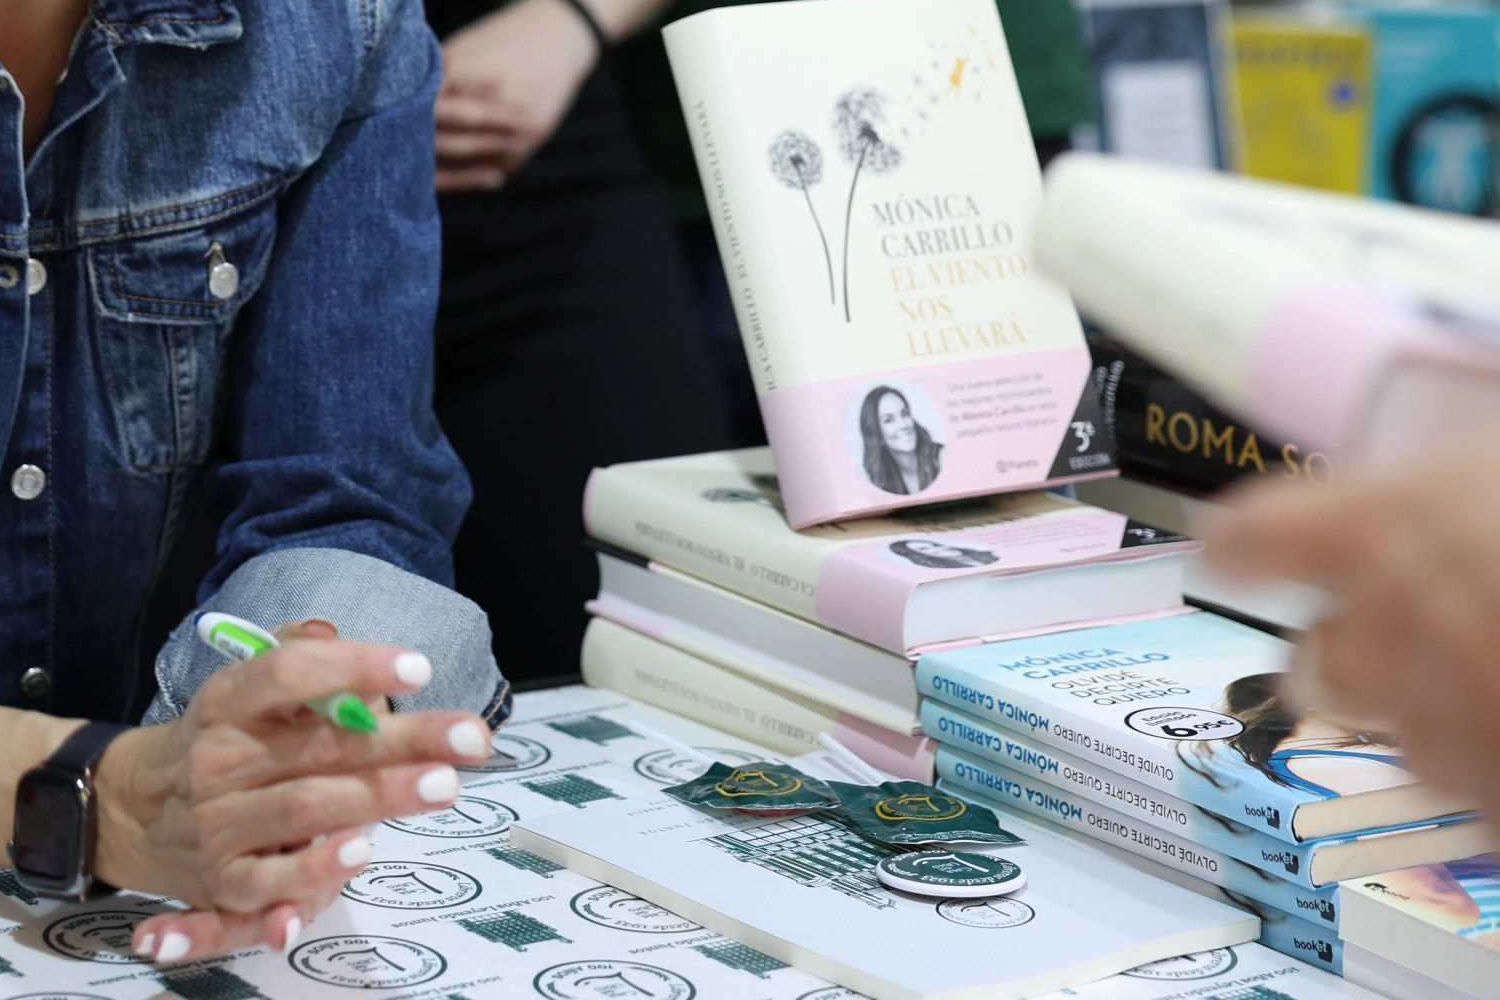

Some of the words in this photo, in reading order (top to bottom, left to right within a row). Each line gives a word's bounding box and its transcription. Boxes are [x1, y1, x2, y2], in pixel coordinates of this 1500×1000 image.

[872, 192, 981, 227] MÓNICA
[881, 220, 1013, 259] CARRILLO
[889, 265, 926, 293] EL
[926, 253, 1028, 286] VIENTO
[897, 294, 954, 325] NOS
[906, 311, 1028, 358] LLEVARÁ
[1145, 403, 1266, 474] ROMA
[1280, 443, 1342, 486] SO
[998, 648, 1126, 671] MÓNICA
[1022, 652, 1171, 679] CARRILLO
[1051, 669, 1144, 690] OLVIDÉ
[1070, 677, 1179, 698] DECIRTE
[932, 675, 994, 710] CARRILLO
[1093, 687, 1191, 706] QUIERO
[997, 699, 1050, 732] MÓNICA
[1141, 710, 1182, 723] Edición
[1145, 712, 1197, 727] limitada
[937, 716, 1001, 752] CARRILLO
[1053, 724, 1092, 748] QUIERO
[1005, 741, 1059, 774] MÓNICA
[1094, 739, 1135, 766] DECIRTE
[1137, 756, 1175, 781] OLVIDÉ
[954, 763, 1022, 798] CARRILLO
[1063, 766, 1102, 790] QUIERO
[1025, 787, 1082, 821] MÓNICA
[1105, 783, 1147, 810] DECIRTE
[1149, 800, 1188, 826] OLVIDÉ
[1245, 805, 1276, 820] booket
[449, 828, 484, 837] desde
[1087, 813, 1129, 837] QUIERO
[423, 845, 466, 857] Juntos
[469, 837, 510, 850] yendo
[1131, 829, 1176, 857] DECIRTE
[1178, 846, 1218, 875] OLVIDÉ
[1261, 850, 1295, 865] booket
[921, 874, 955, 883] 1923
[959, 875, 994, 885] desde
[135, 895, 177, 907] untos
[371, 896, 404, 906] 1923
[408, 899, 445, 907] desde
[496, 899, 530, 909] Años
[531, 894, 556, 902] 100
[587, 888, 618, 902] AÑOS
[438, 905, 494, 921] Leyendo
[1296, 897, 1330, 913] booket
[391, 916, 438, 928] Juntos
[614, 919, 648, 929] 1923
[652, 922, 690, 930] desde
[628, 942, 675, 955] Juntos
[1293, 938, 1328, 953] booket
[1165, 967, 1205, 977] desde
[1240, 972, 1274, 983] Años
[1274, 966, 1300, 975] 100
[1184, 978, 1239, 996] Leyendo
